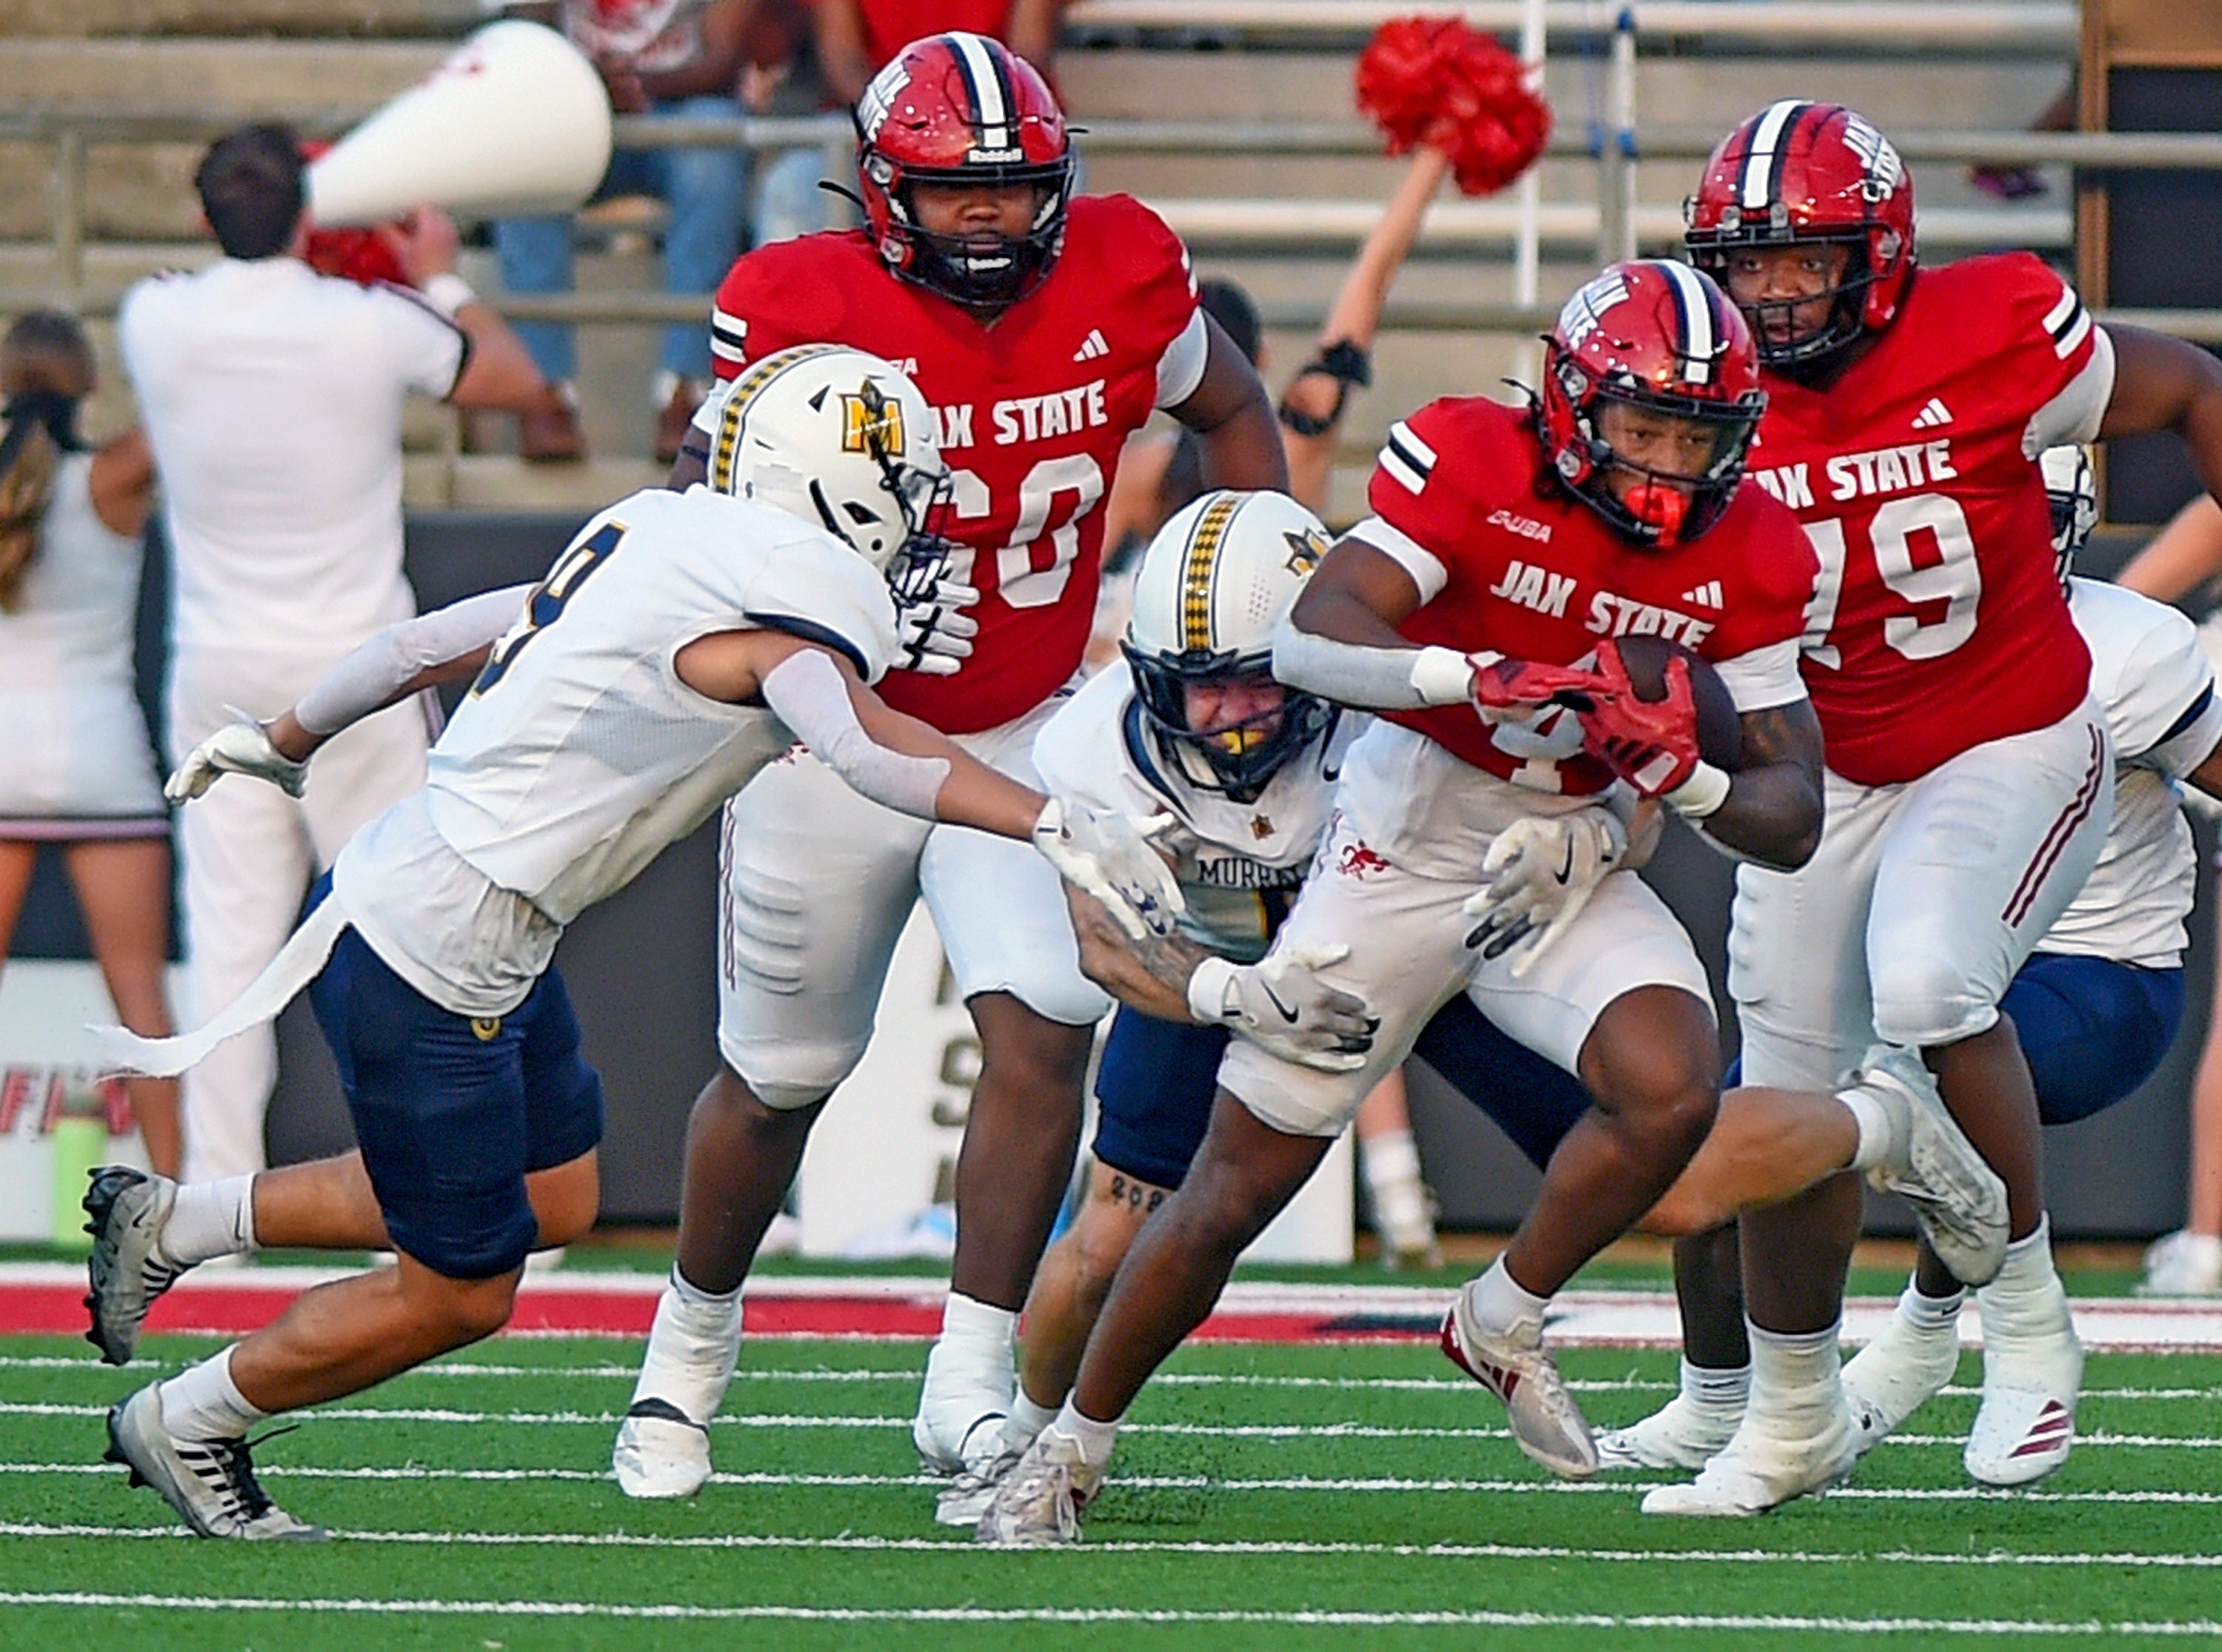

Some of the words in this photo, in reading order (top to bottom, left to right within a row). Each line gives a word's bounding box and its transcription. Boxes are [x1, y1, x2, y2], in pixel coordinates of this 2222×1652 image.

[992, 378, 1109, 446] STATE
[1826, 438, 1958, 502] STATE
[1489, 559, 1578, 619] JAX
[1584, 590, 1715, 653] STATE
